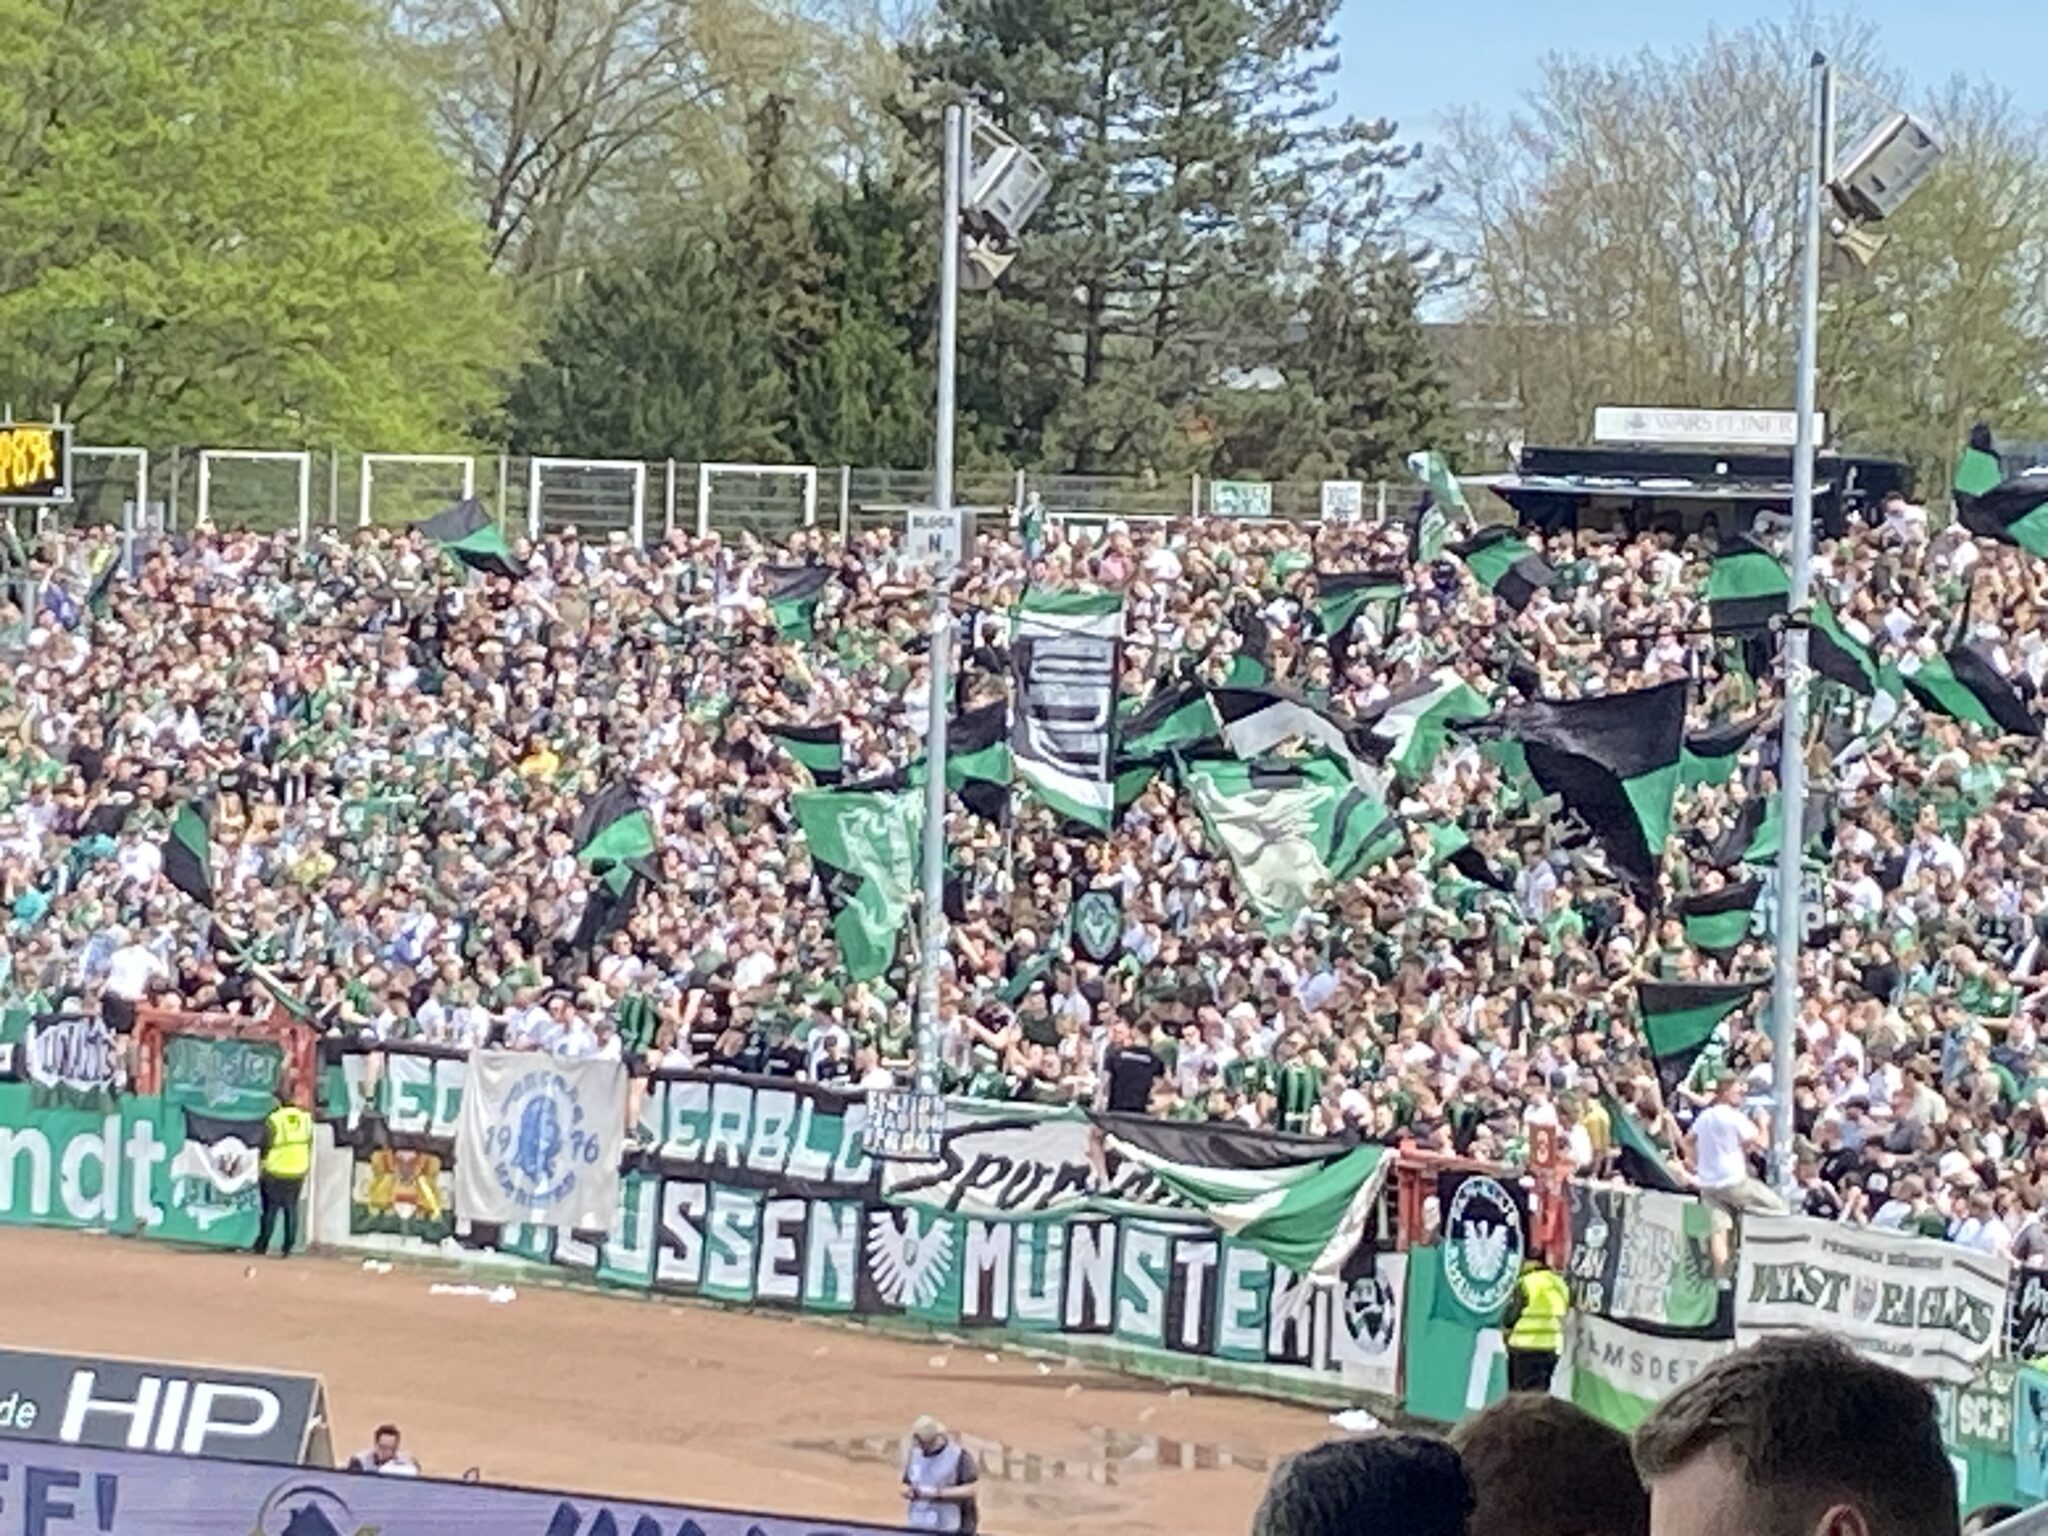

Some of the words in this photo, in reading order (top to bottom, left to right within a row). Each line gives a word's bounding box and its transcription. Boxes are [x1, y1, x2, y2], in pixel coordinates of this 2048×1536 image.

[928, 532, 942, 553] N
[1748, 1262, 1850, 1313] WEST
[1875, 1282, 1995, 1344] EAGLES
[60, 1370, 281, 1455] HIP
